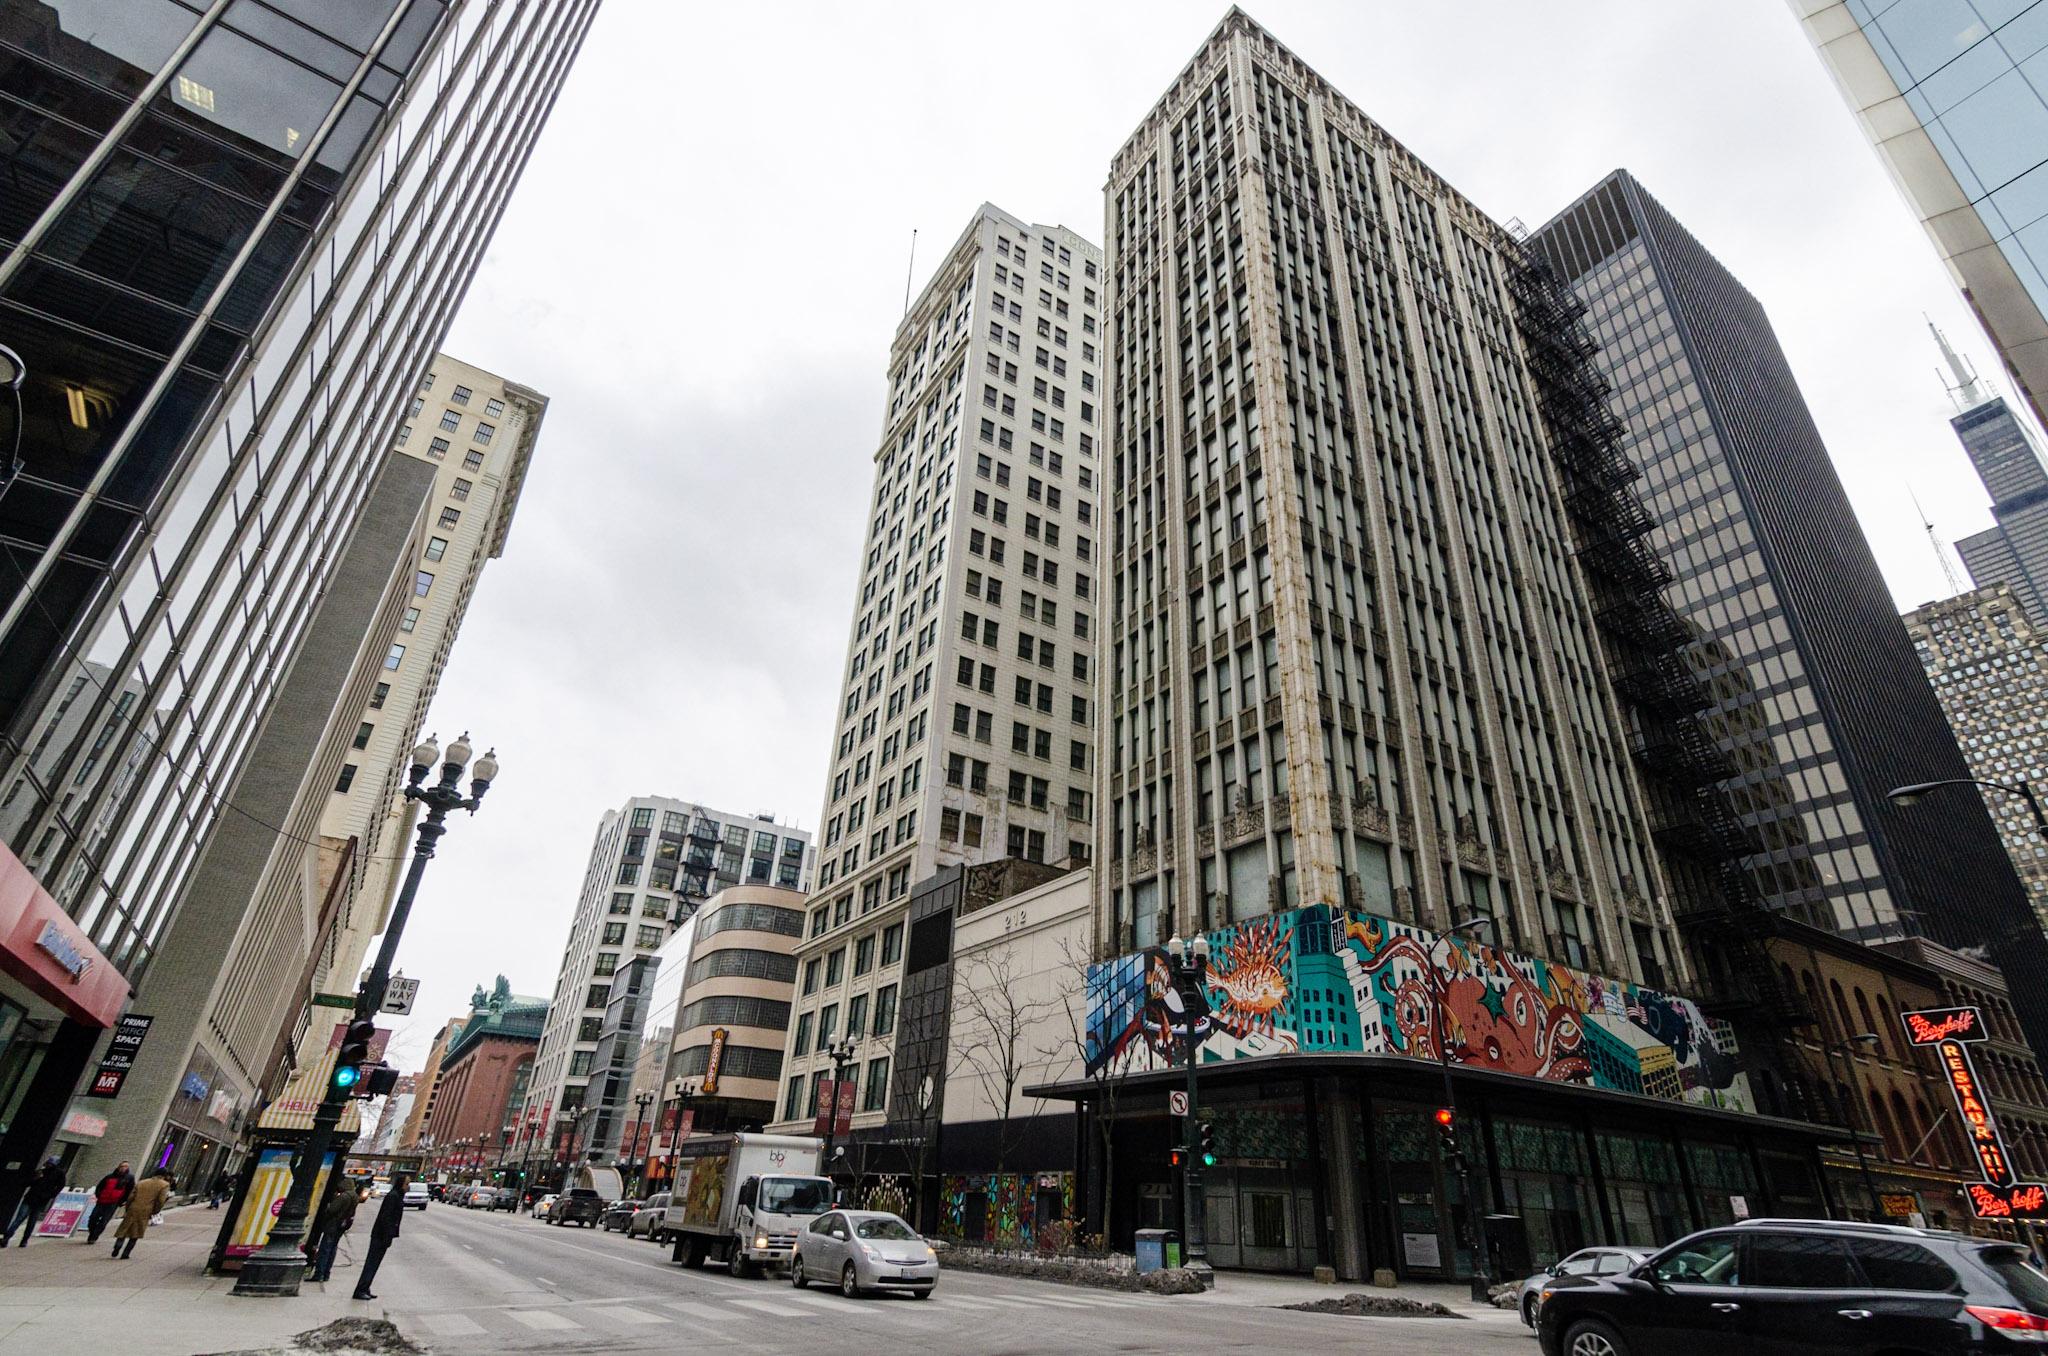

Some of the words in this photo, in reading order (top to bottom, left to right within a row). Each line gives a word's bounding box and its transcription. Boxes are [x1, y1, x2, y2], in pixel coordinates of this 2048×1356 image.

[392, 980, 416, 992] ONE
[388, 989, 414, 1001] WAY
[123, 1017, 150, 1028] PRIME
[1914, 1010, 1975, 1043] Berghoff
[118, 1026, 146, 1036] OFFICE
[115, 1035, 142, 1045] SPACE
[97, 1075, 119, 1089] MR
